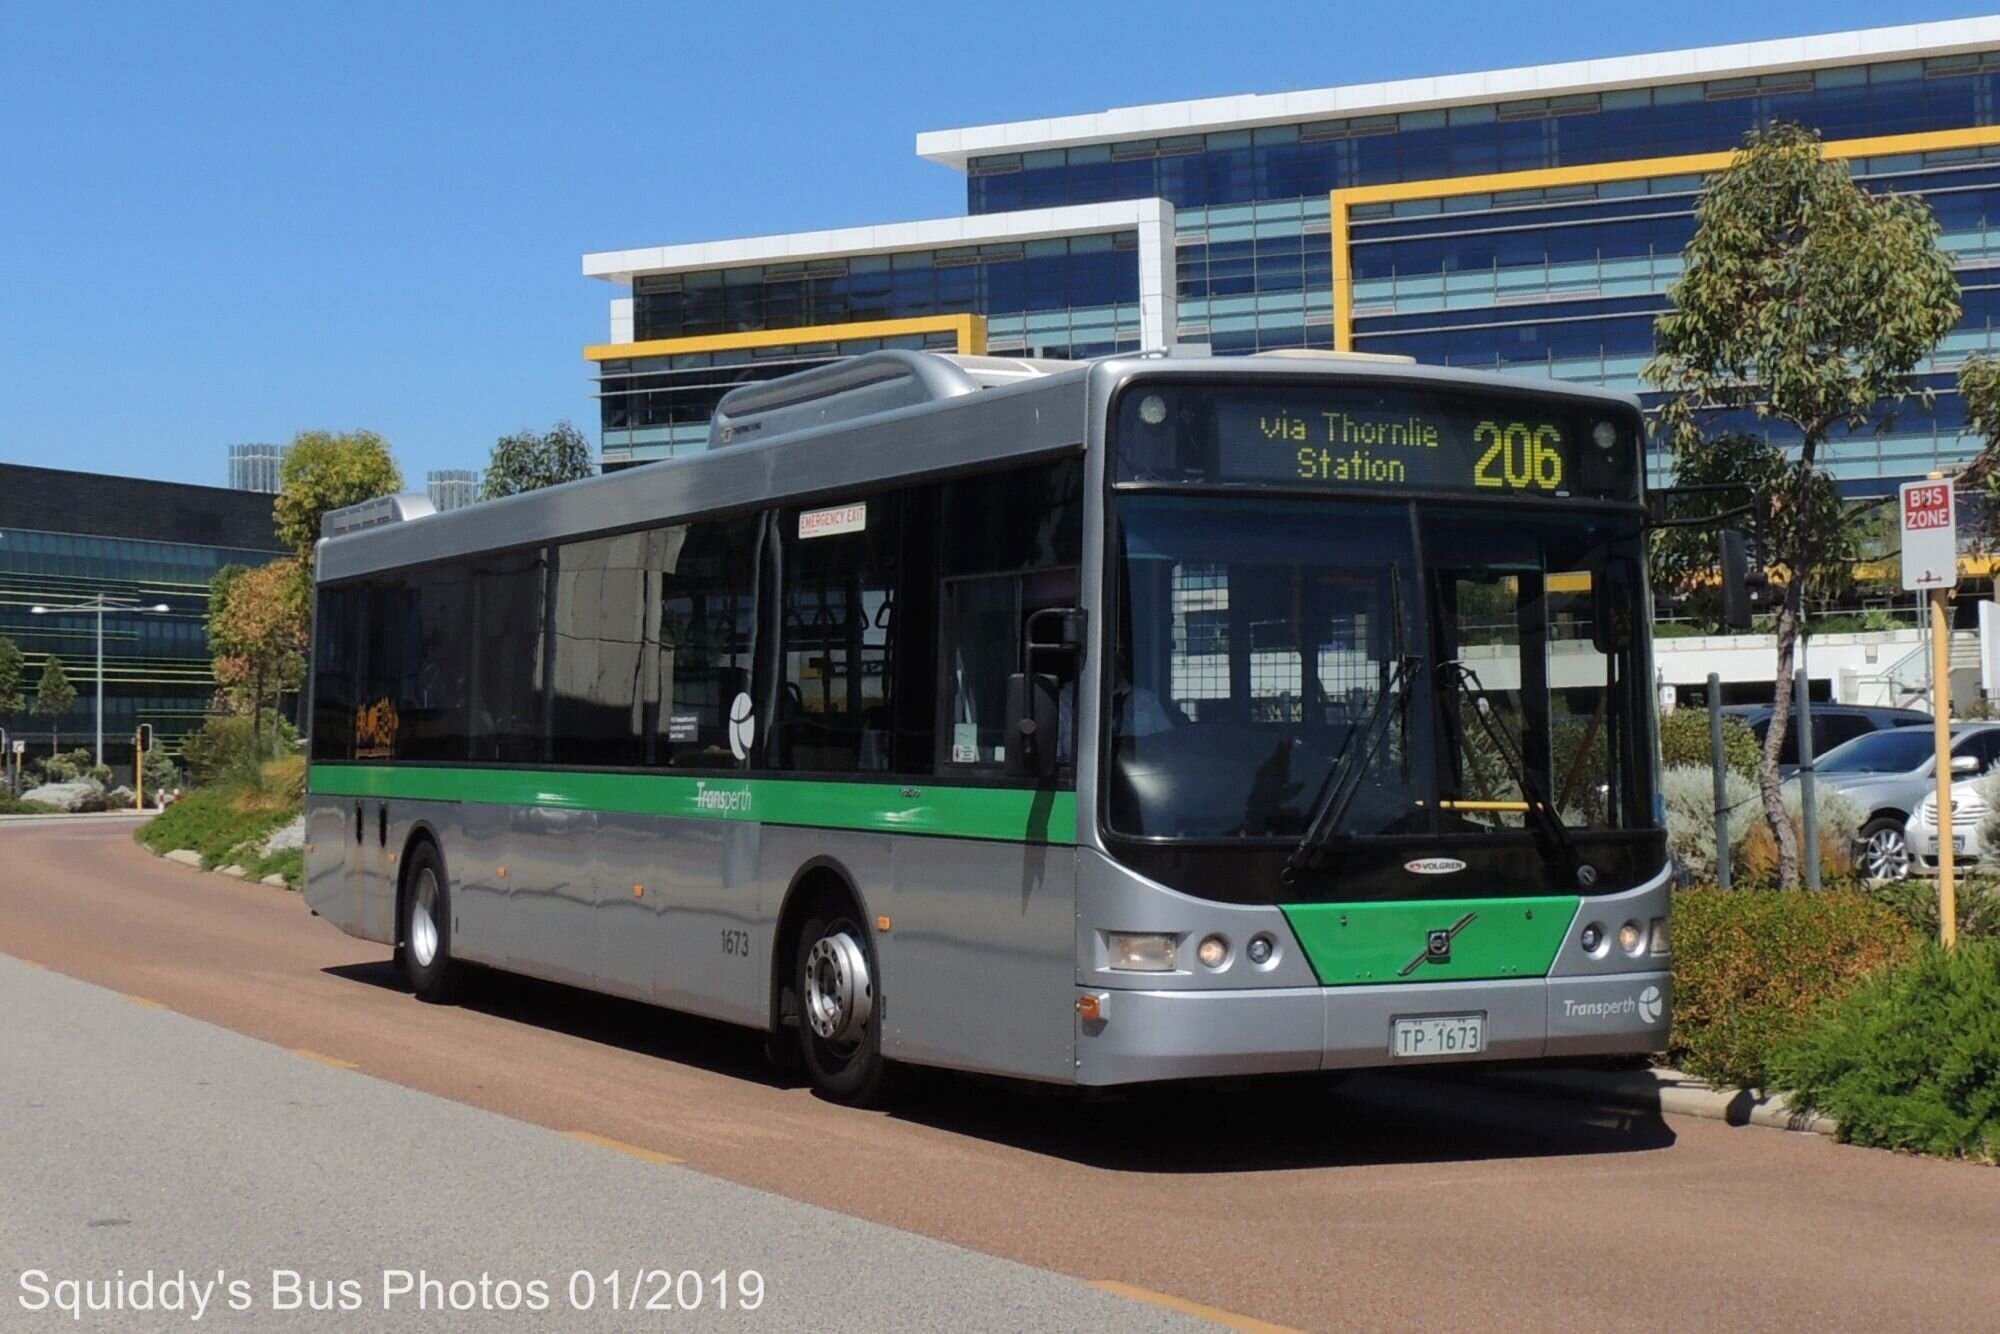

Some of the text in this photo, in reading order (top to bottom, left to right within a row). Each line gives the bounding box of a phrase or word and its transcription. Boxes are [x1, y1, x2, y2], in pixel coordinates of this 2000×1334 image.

[1260, 409, 1438, 447] via Thornlie
[1297, 447, 1405, 482] Station
[1473, 420, 1562, 489] 206
[1910, 487, 1943, 508] BUS
[801, 507, 864, 530] EMERGENCY EXIT
[1907, 508, 1949, 529] ZONE
[696, 781, 752, 818] Transperth
[1422, 862, 1463, 870] VOLGREN
[720, 929, 749, 957] 1673
[1563, 995, 1636, 1019] Transperth
